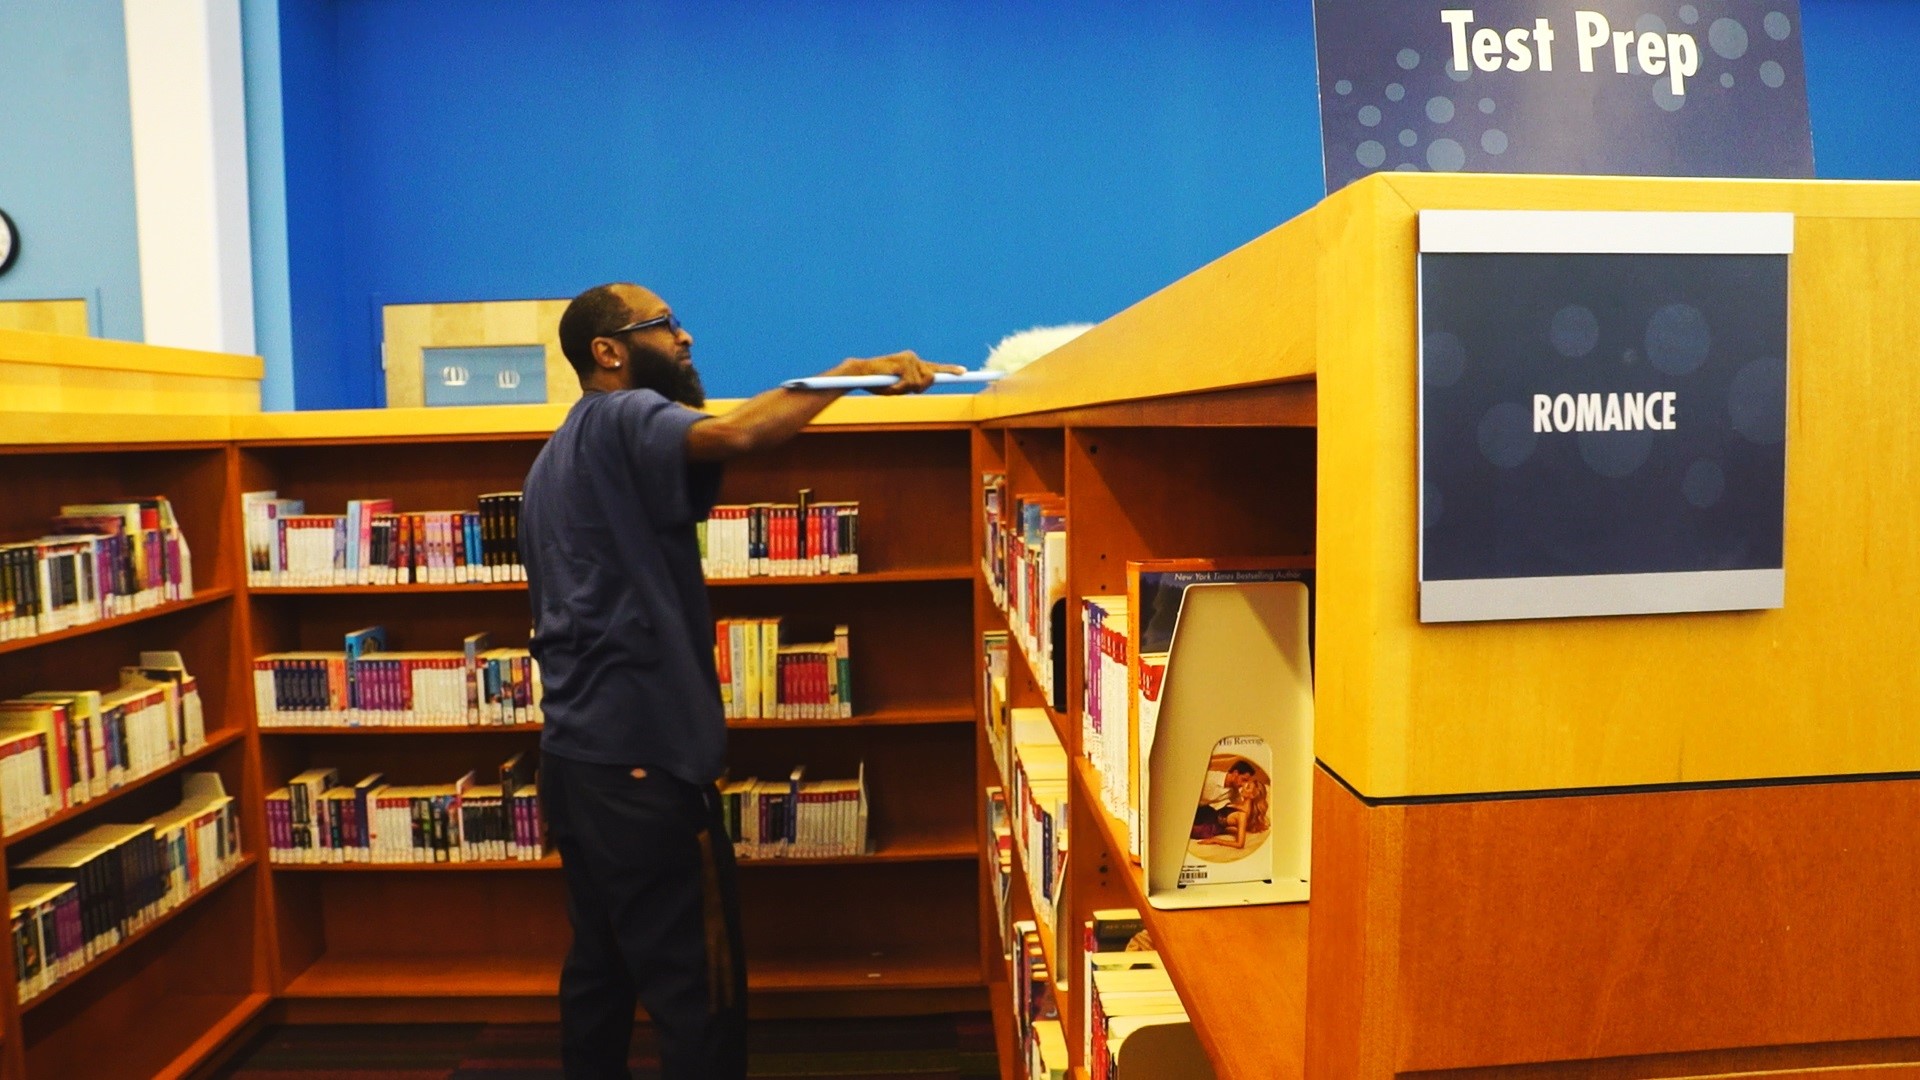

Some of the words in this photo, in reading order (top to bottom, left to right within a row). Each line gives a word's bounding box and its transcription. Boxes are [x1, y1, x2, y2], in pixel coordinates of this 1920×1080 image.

[1440, 9, 1555, 72] Test
[1574, 10, 1699, 96] Prep
[1533, 391, 1677, 433] ROMANCE
[1174, 572, 1193, 582] New
[1195, 572, 1211, 581] York
[1213, 572, 1234, 581] Times
[1236, 571, 1274, 581] Bestselling
[1276, 570, 1301, 580] Author
